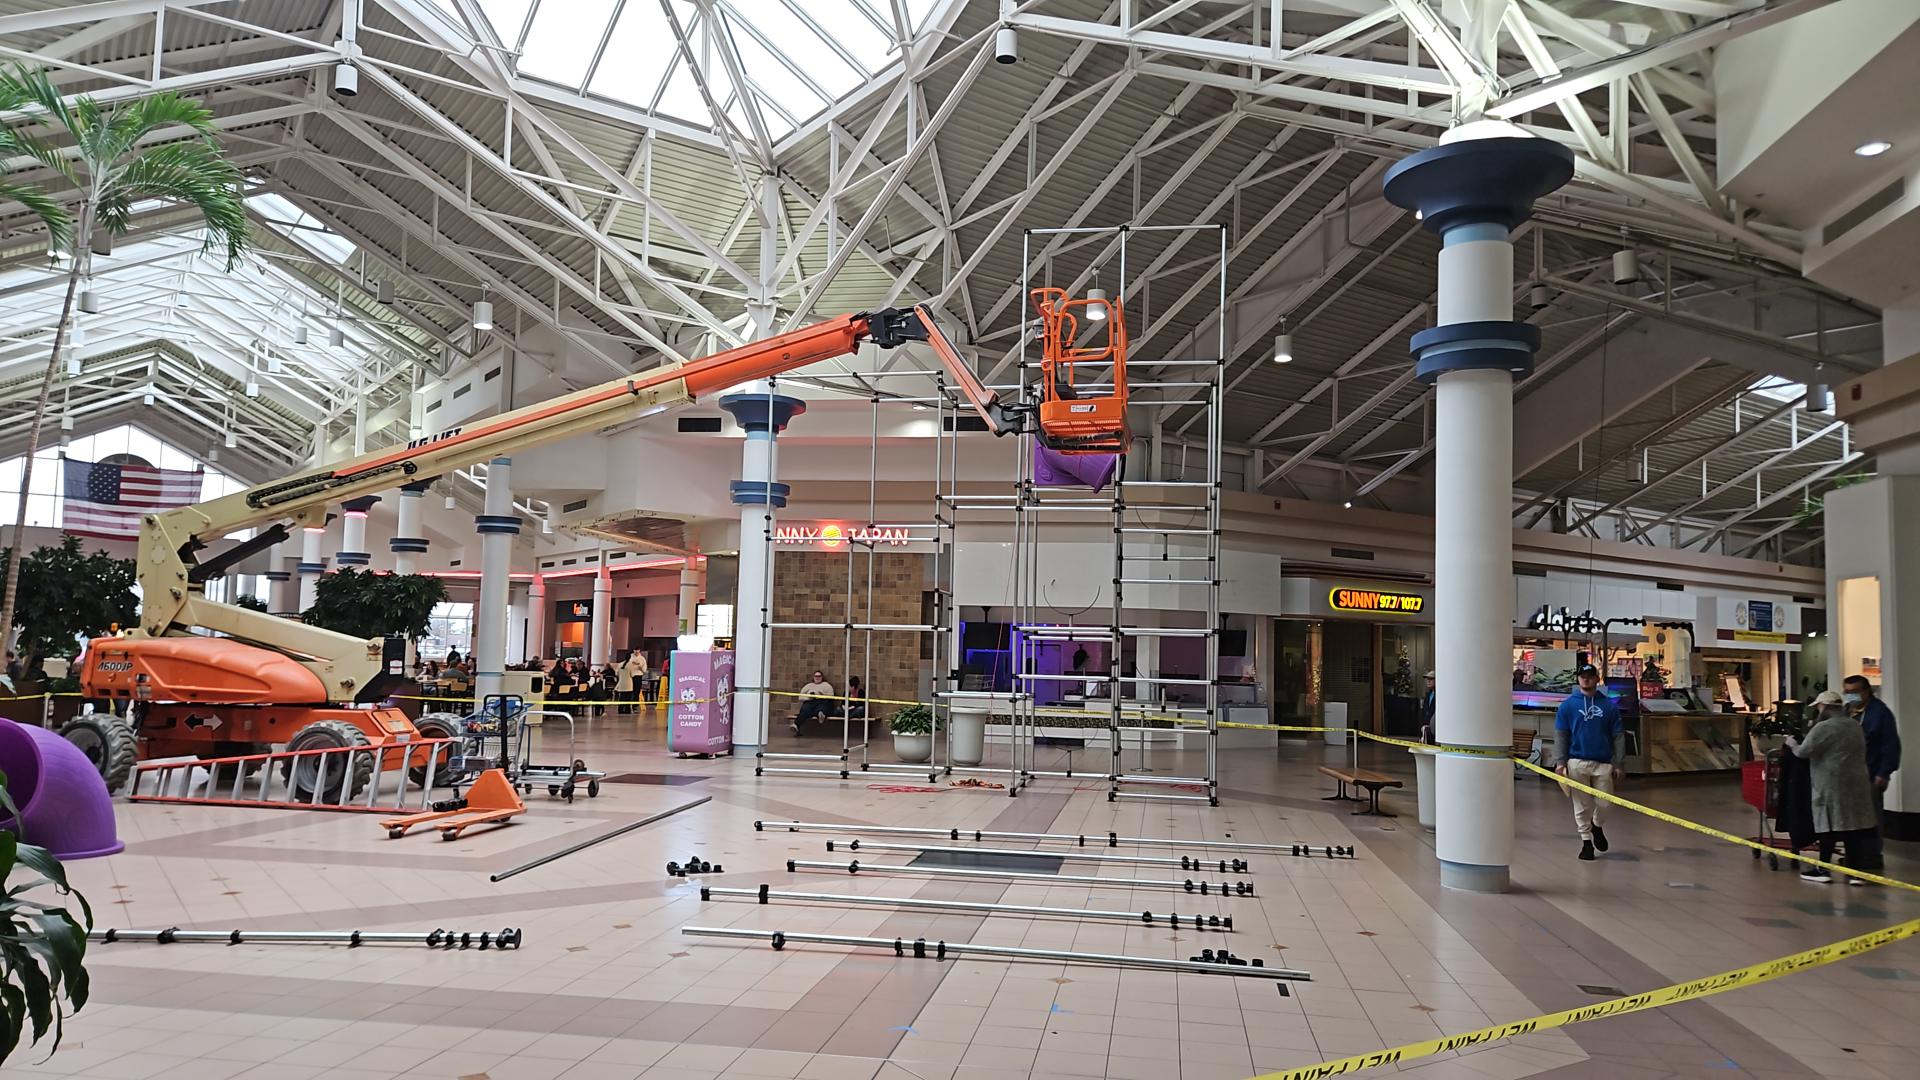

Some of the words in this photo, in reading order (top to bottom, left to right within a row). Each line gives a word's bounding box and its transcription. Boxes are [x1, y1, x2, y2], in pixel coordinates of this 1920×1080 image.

[775, 526, 818, 545] NNY
[847, 528, 909, 546] JAPAN
[1338, 590, 1380, 609] SUNNY
[1379, 595, 1423, 611] 97.7/107.7
[678, 675, 706, 684] MAGICAL
[1355, 1051, 1402, 1072] WET
